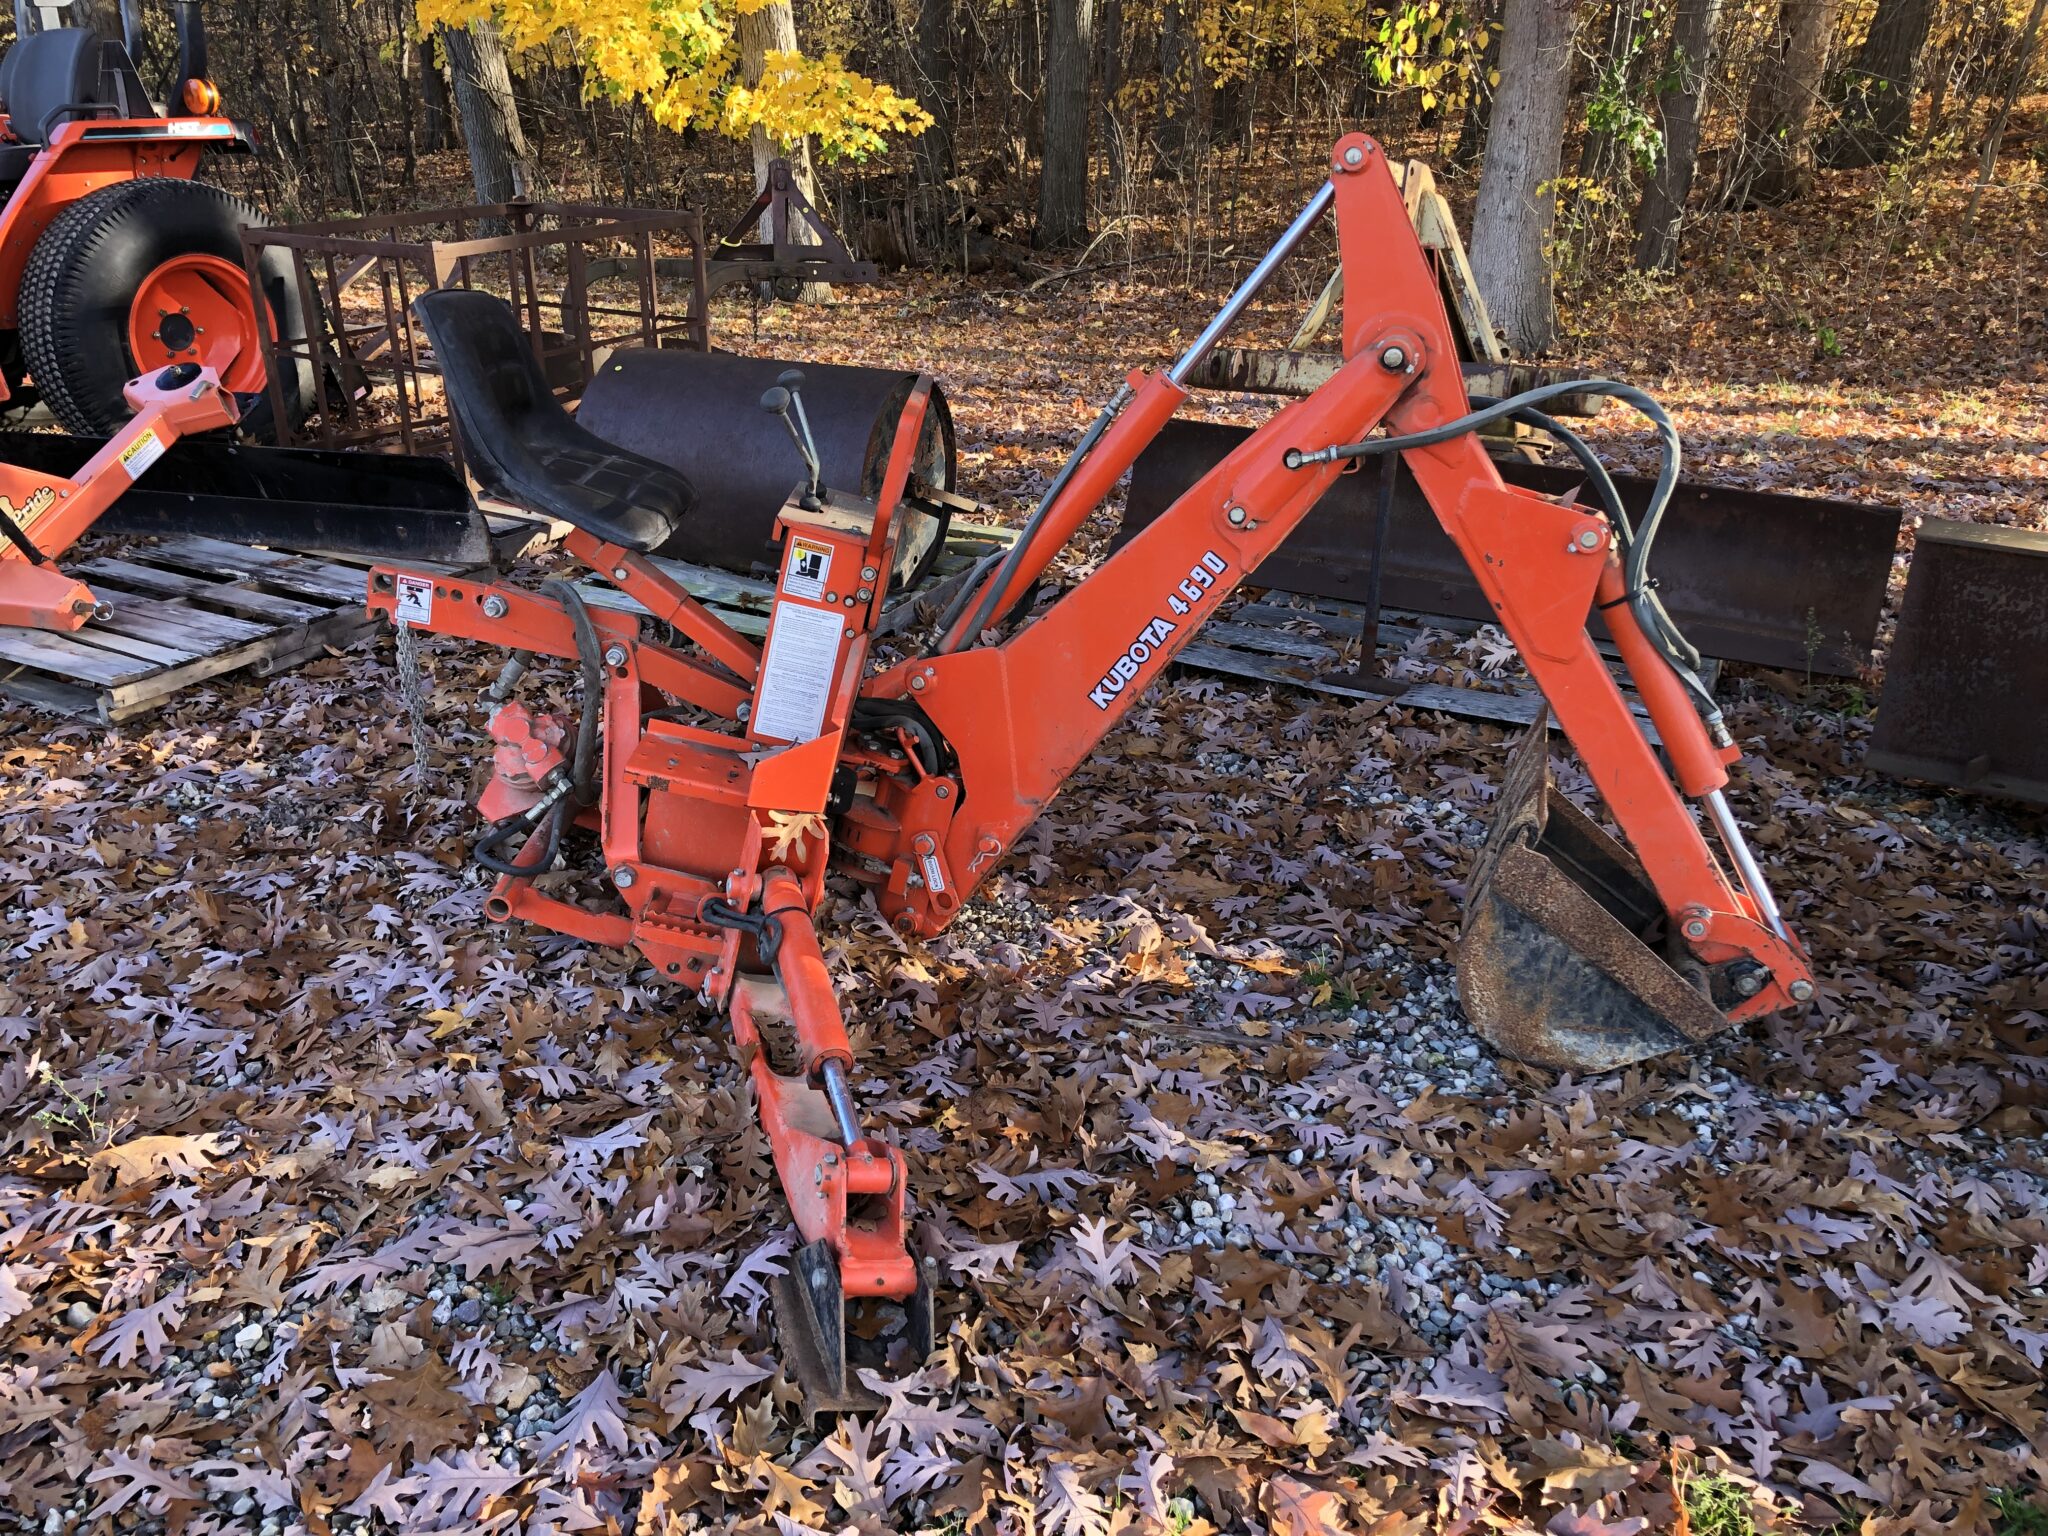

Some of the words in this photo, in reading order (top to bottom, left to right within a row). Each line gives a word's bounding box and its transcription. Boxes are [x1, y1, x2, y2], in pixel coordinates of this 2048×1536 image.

[126, 431, 152, 457] CAUTION
[14, 485, 52, 525] Pride
[801, 541, 830, 554] WARNING
[408, 580, 430, 588] DANGER
[1088, 616, 1178, 711] KUBOTA
[1167, 550, 1228, 616] 4690
